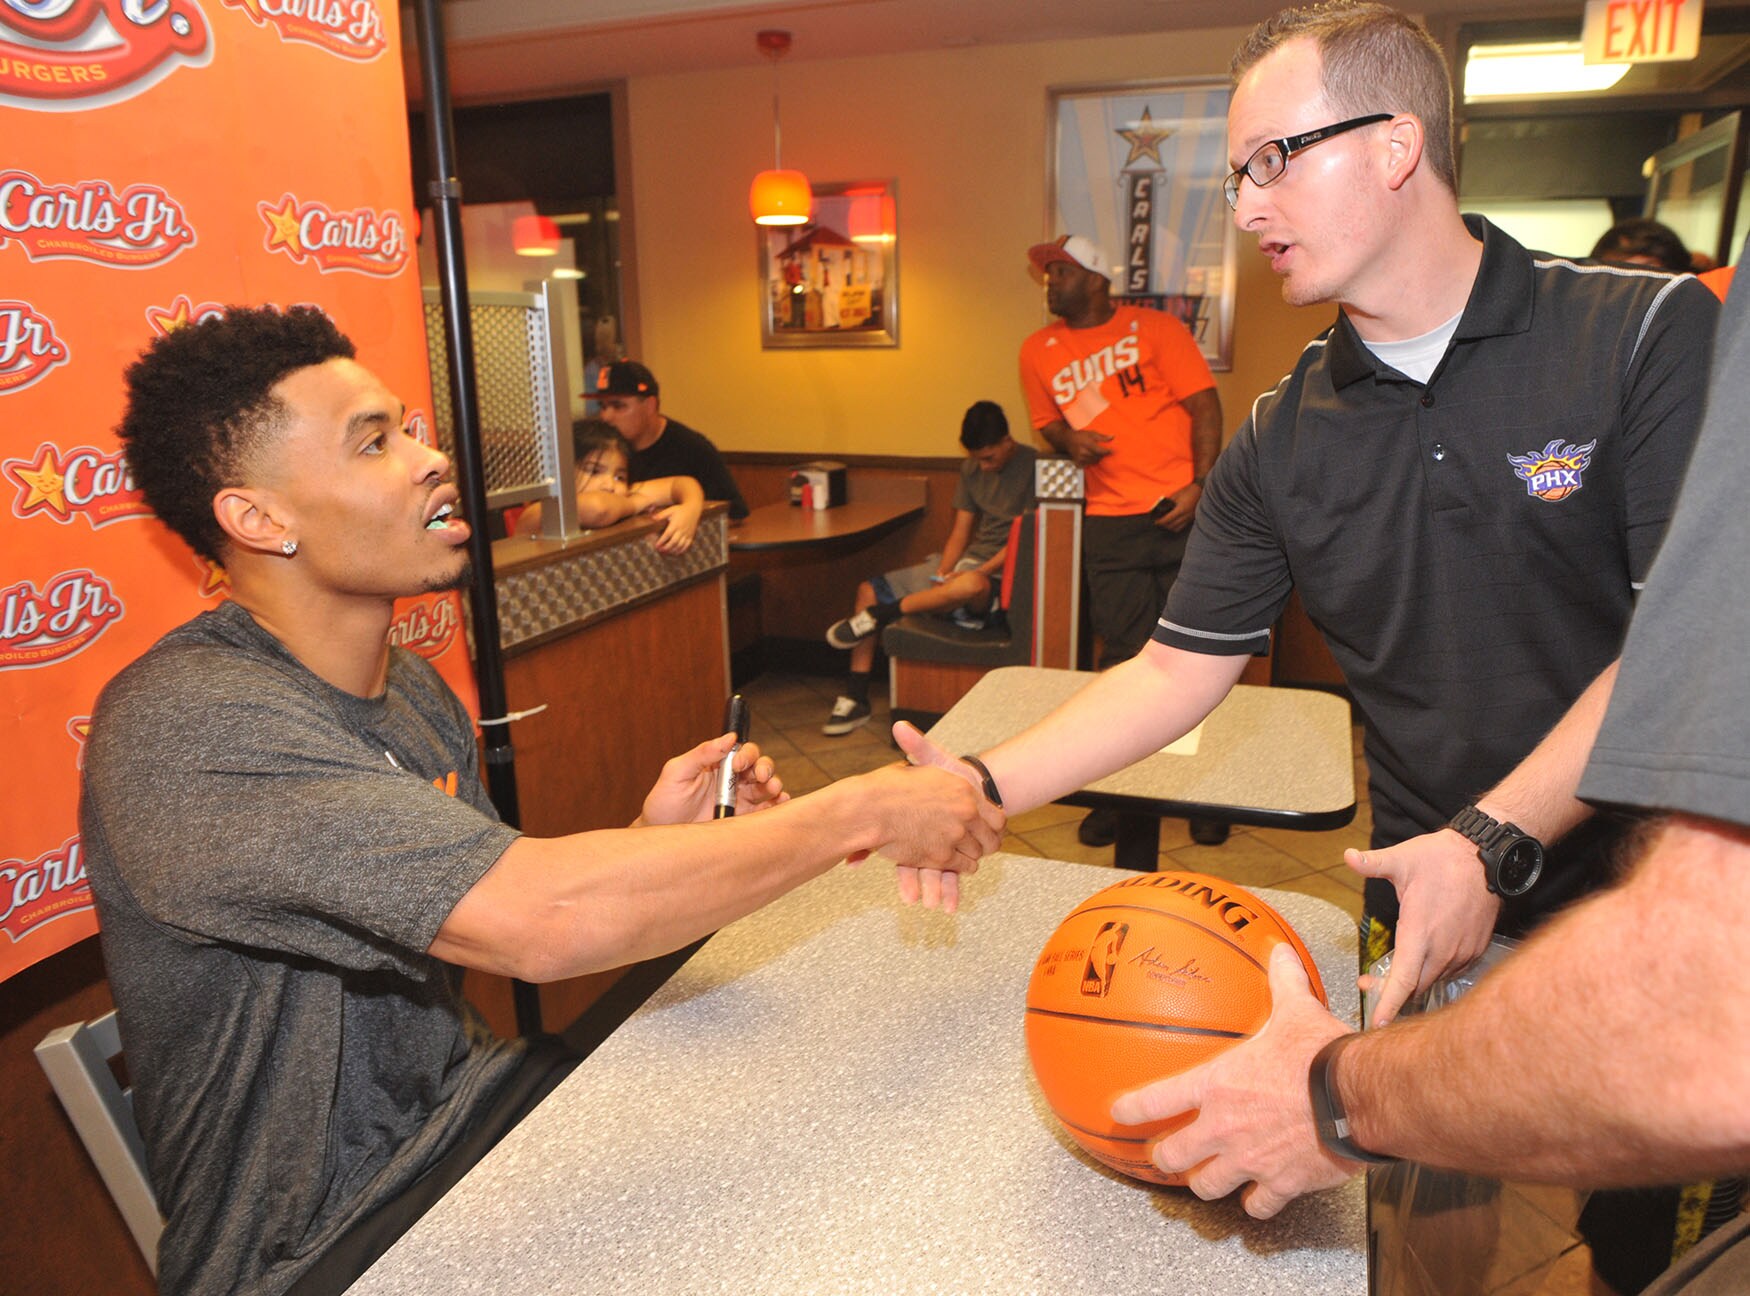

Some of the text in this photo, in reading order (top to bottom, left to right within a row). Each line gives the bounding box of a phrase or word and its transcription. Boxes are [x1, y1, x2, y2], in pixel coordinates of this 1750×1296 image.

[1603, 0, 1686, 58] EXIT
[0, 179, 189, 241] Carl's Jr.
[300, 209, 380, 250] Carl's
[1117, 363, 1146, 398] 14
[1531, 469, 1578, 491] PHX
[49, 577, 117, 632] Jr.
[1081, 980, 1101, 994] NBA
